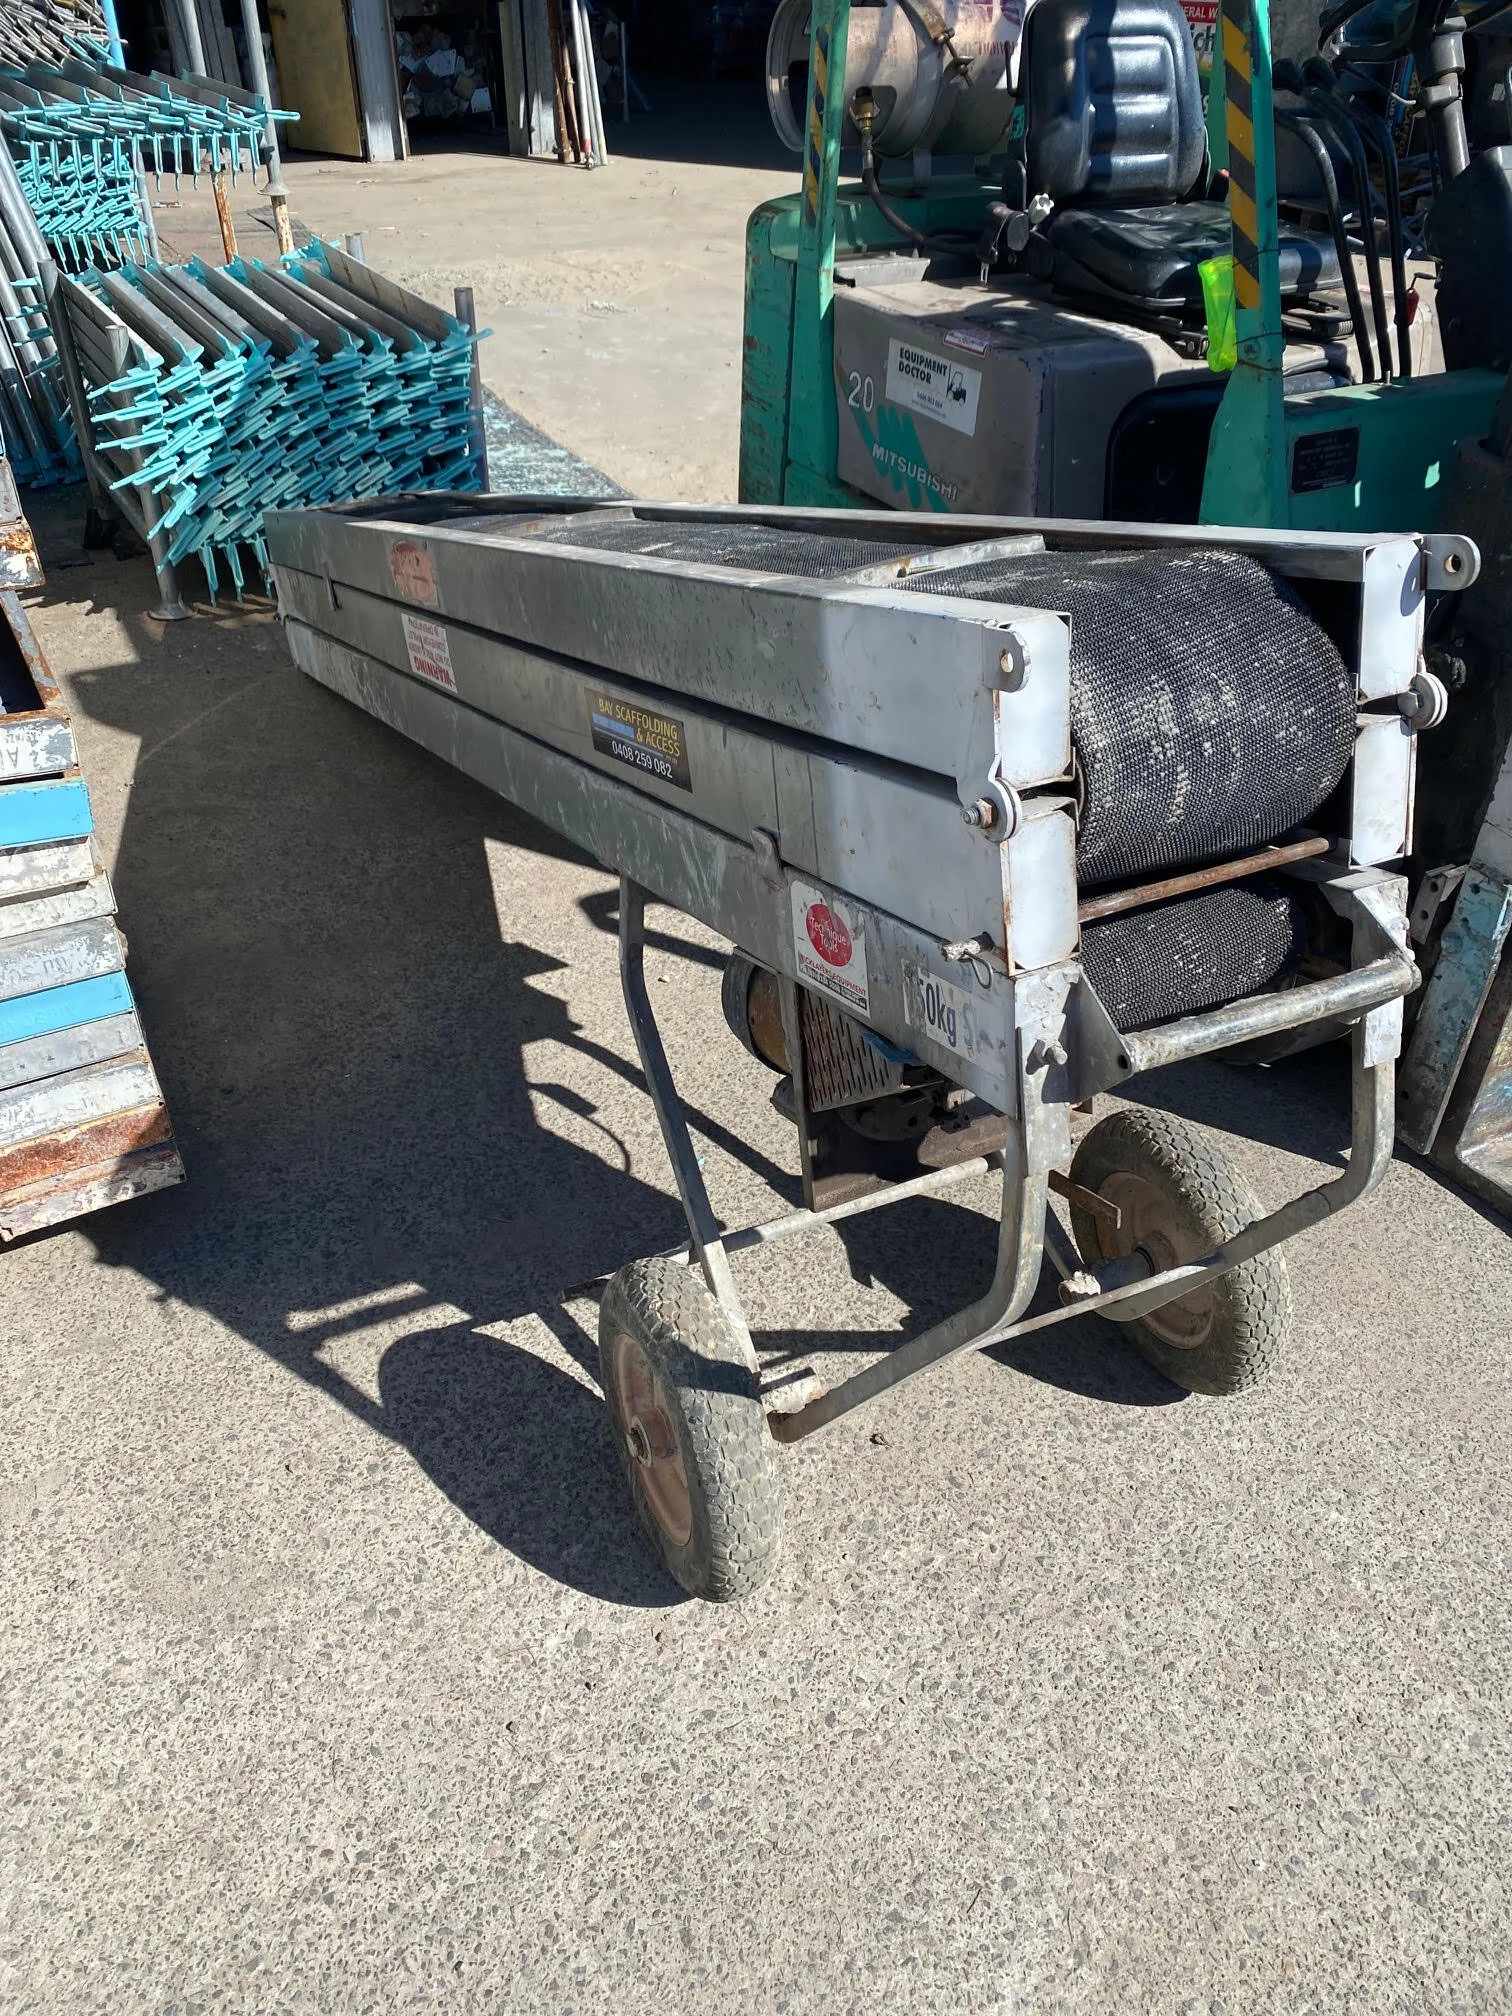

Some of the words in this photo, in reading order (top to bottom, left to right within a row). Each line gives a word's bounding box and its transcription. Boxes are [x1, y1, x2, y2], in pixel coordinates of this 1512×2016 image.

[1183, 6, 1206, 19] ERAL
[898, 362, 932, 385] DOCTOR
[900, 347, 948, 377] EQUIPMENT
[848, 371, 874, 413] 20
[872, 442, 959, 500] MITSUBISHI
[414, 657, 453, 687] WARNING
[598, 698, 613, 716] BAY
[615, 704, 677, 739] SCAFFOLDING
[636, 727, 643, 743] &
[645, 731, 680, 757] ACCESS
[611, 740, 634, 761] 0408
[634, 750, 652, 770] 259
[653, 758, 673, 778] 082
[832, 970, 867, 997] EQUIPMENT
[915, 974, 957, 1048] 0kg
